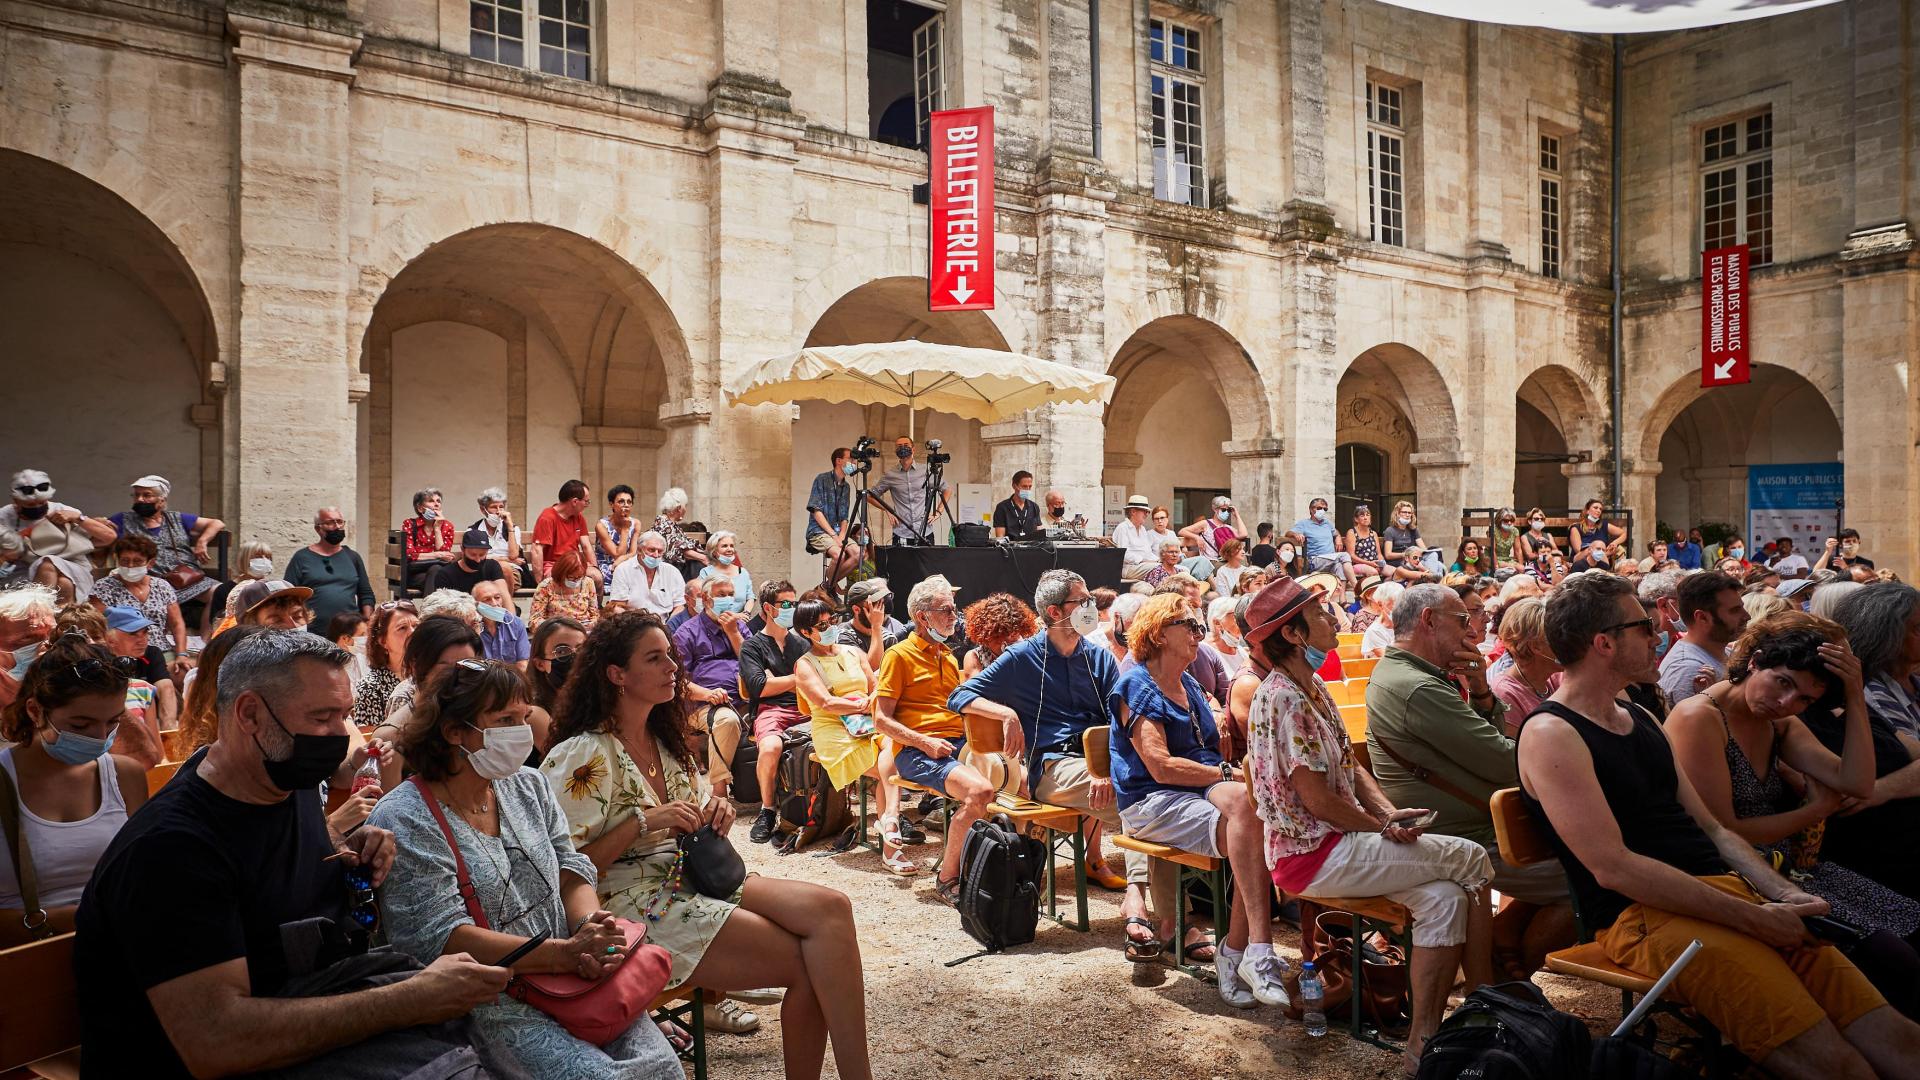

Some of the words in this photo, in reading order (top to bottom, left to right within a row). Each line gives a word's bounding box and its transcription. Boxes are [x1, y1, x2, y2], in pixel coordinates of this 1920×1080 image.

[946, 125, 978, 273] BILLETTERIE
[1711, 255, 1723, 266] ET
[1728, 253, 1740, 291] MAISON
[1711, 268, 1723, 284] DES
[1728, 293, 1740, 310] DES
[1711, 284, 1723, 353] PROFESSIONNELS
[1728, 313, 1741, 351] PUBLICS
[1758, 476, 1787, 485] MAISON
[1788, 475, 1803, 485] DES
[1805, 474, 1836, 485] PUBLICS
